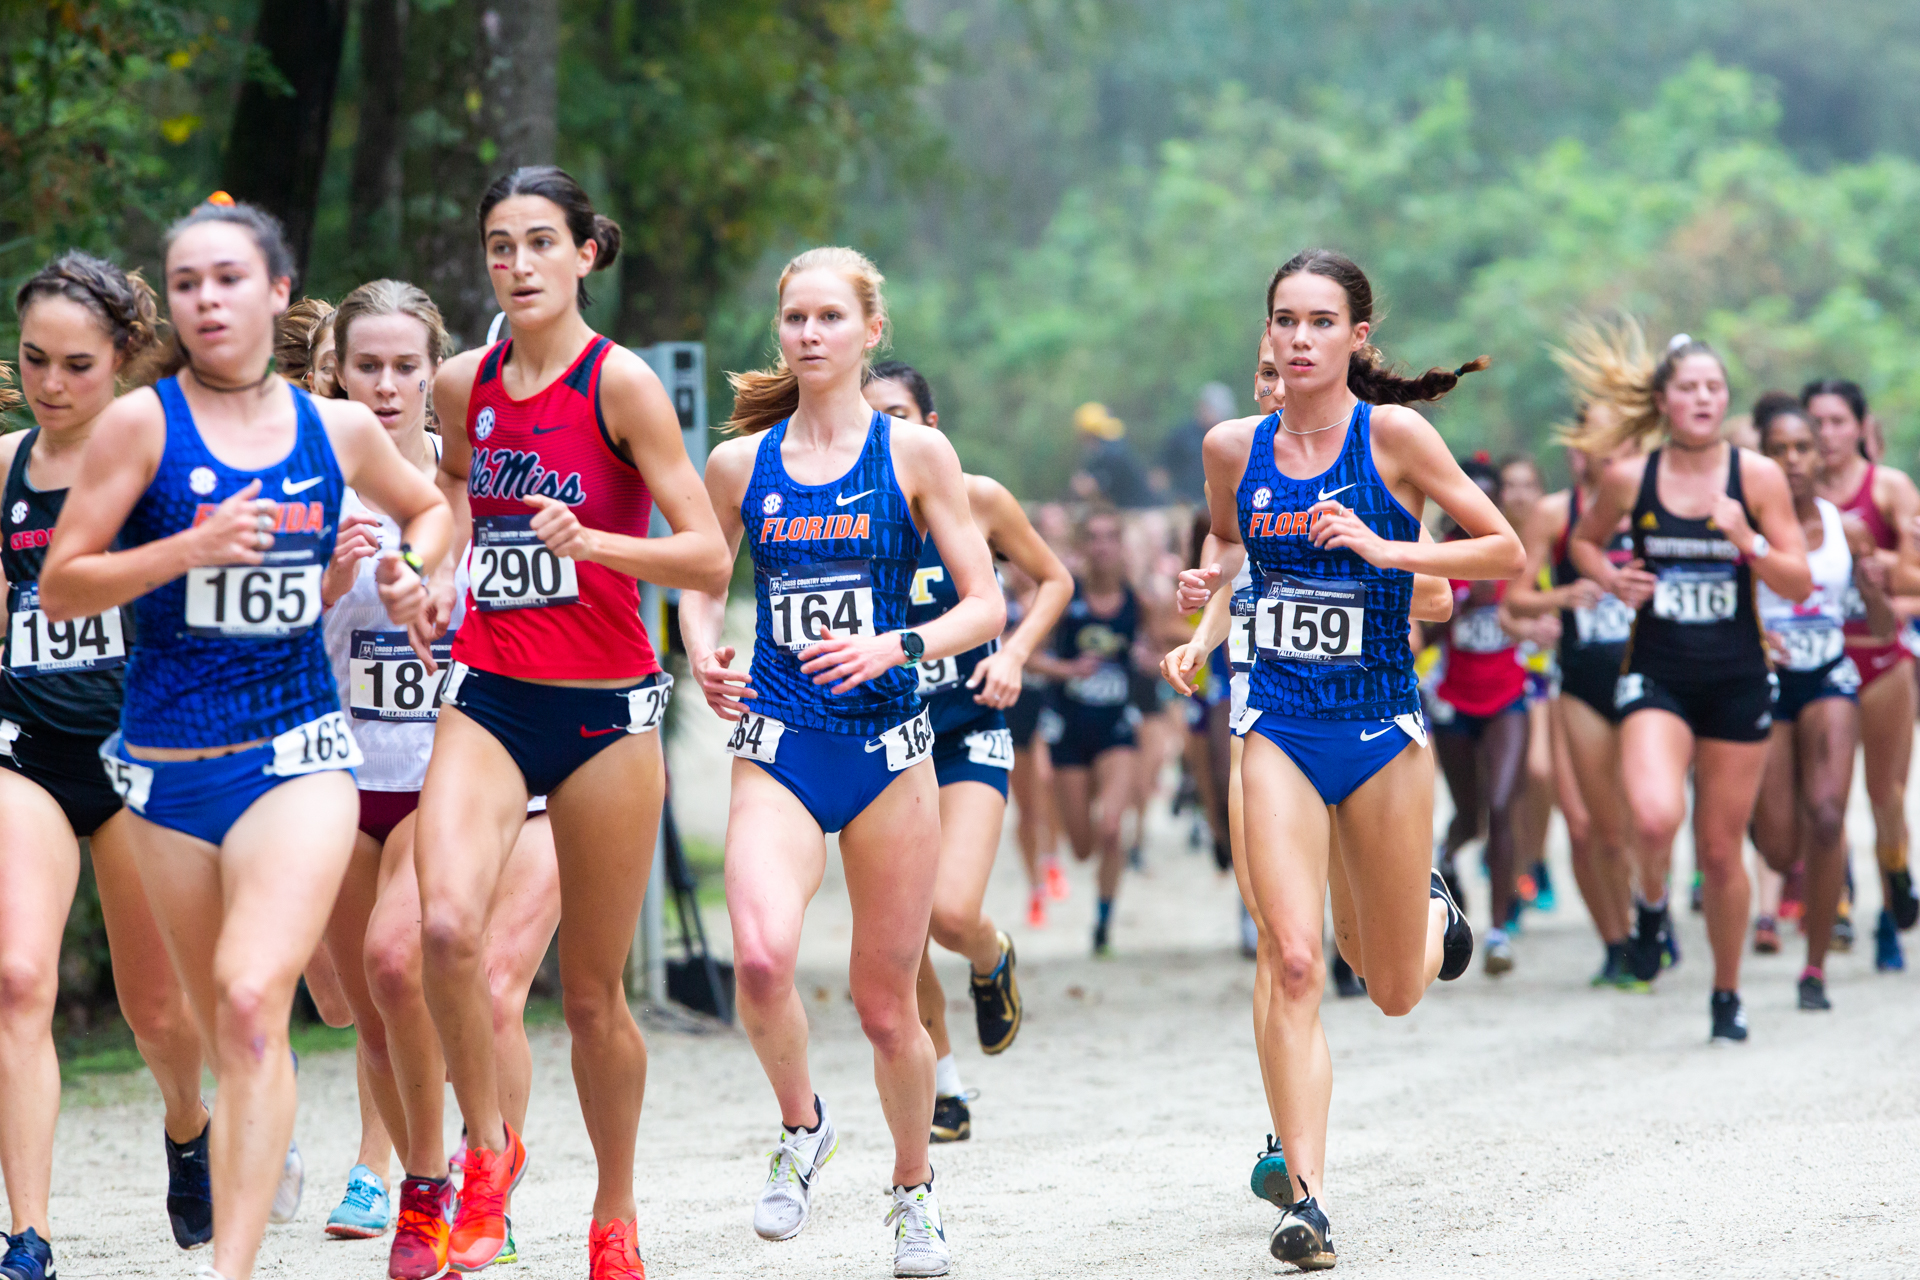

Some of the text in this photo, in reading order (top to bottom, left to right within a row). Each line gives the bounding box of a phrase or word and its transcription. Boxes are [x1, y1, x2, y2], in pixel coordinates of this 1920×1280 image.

[491, 448, 587, 506] Miss
[762, 493, 783, 515] SEC
[1252, 487, 1271, 509] SEC
[759, 513, 870, 544] FLORIDA
[1249, 508, 1354, 538] FLORI
[477, 547, 562, 598] 290
[797, 578, 819, 586] COUNTRY
[820, 574, 861, 583] CHAMPIONSHIPS
[205, 571, 306, 624] 165
[1315, 590, 1355, 600] CHAMPIONSHIPS
[774, 590, 862, 644] 164
[1267, 601, 1350, 655] 159
[23, 612, 110, 662] 194
[393, 645, 414, 653] COUNT
[364, 661, 450, 710] 187
[378, 709, 429, 718] TALLAHASSEE,
[300, 718, 350, 765] 165
